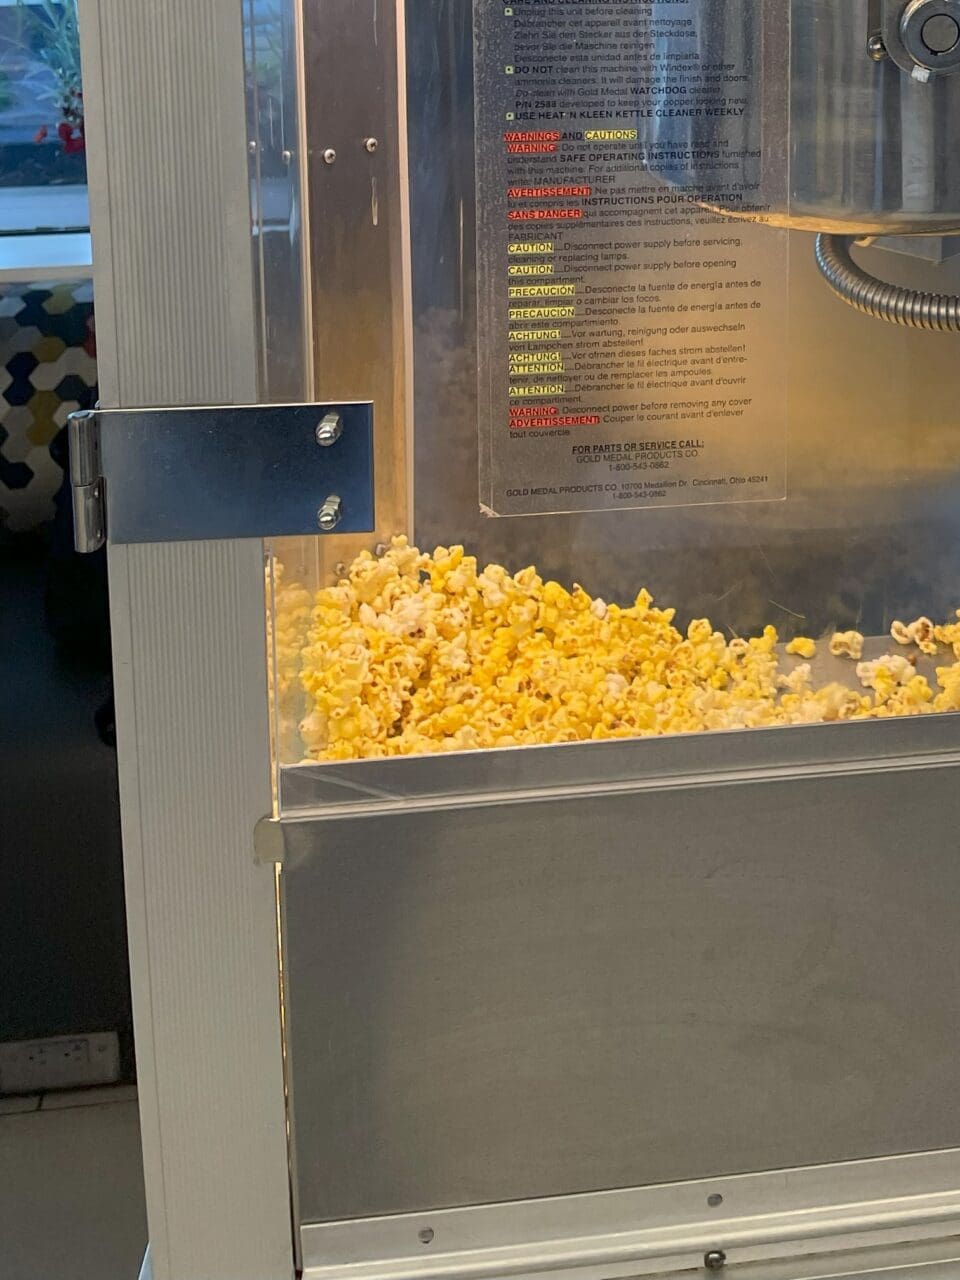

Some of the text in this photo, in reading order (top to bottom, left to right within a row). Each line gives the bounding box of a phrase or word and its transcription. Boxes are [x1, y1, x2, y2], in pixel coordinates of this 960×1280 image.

[515, 66, 529, 74] DO
[516, 112, 537, 120] USE
[616, 109, 653, 118] KETTLE
[655, 109, 701, 117] CLEANER
[705, 107, 744, 116] WEEKLY
[505, 132, 558, 140] WARNINGS
[585, 131, 636, 139] CAUTIONS
[581, 197, 654, 205] INSTRUCTIONS
[688, 194, 742, 202] OPERATION
[508, 210, 580, 219] SANS DANGER
[572, 446, 590, 454] FOR
[593, 444, 621, 452] PARTS
[639, 441, 676, 450] SERVICE
[680, 440, 704, 448] CALL:
[577, 455, 600, 463] GOLD
[604, 454, 632, 462] MEDAL
[635, 450, 682, 460] PRODUCTS
